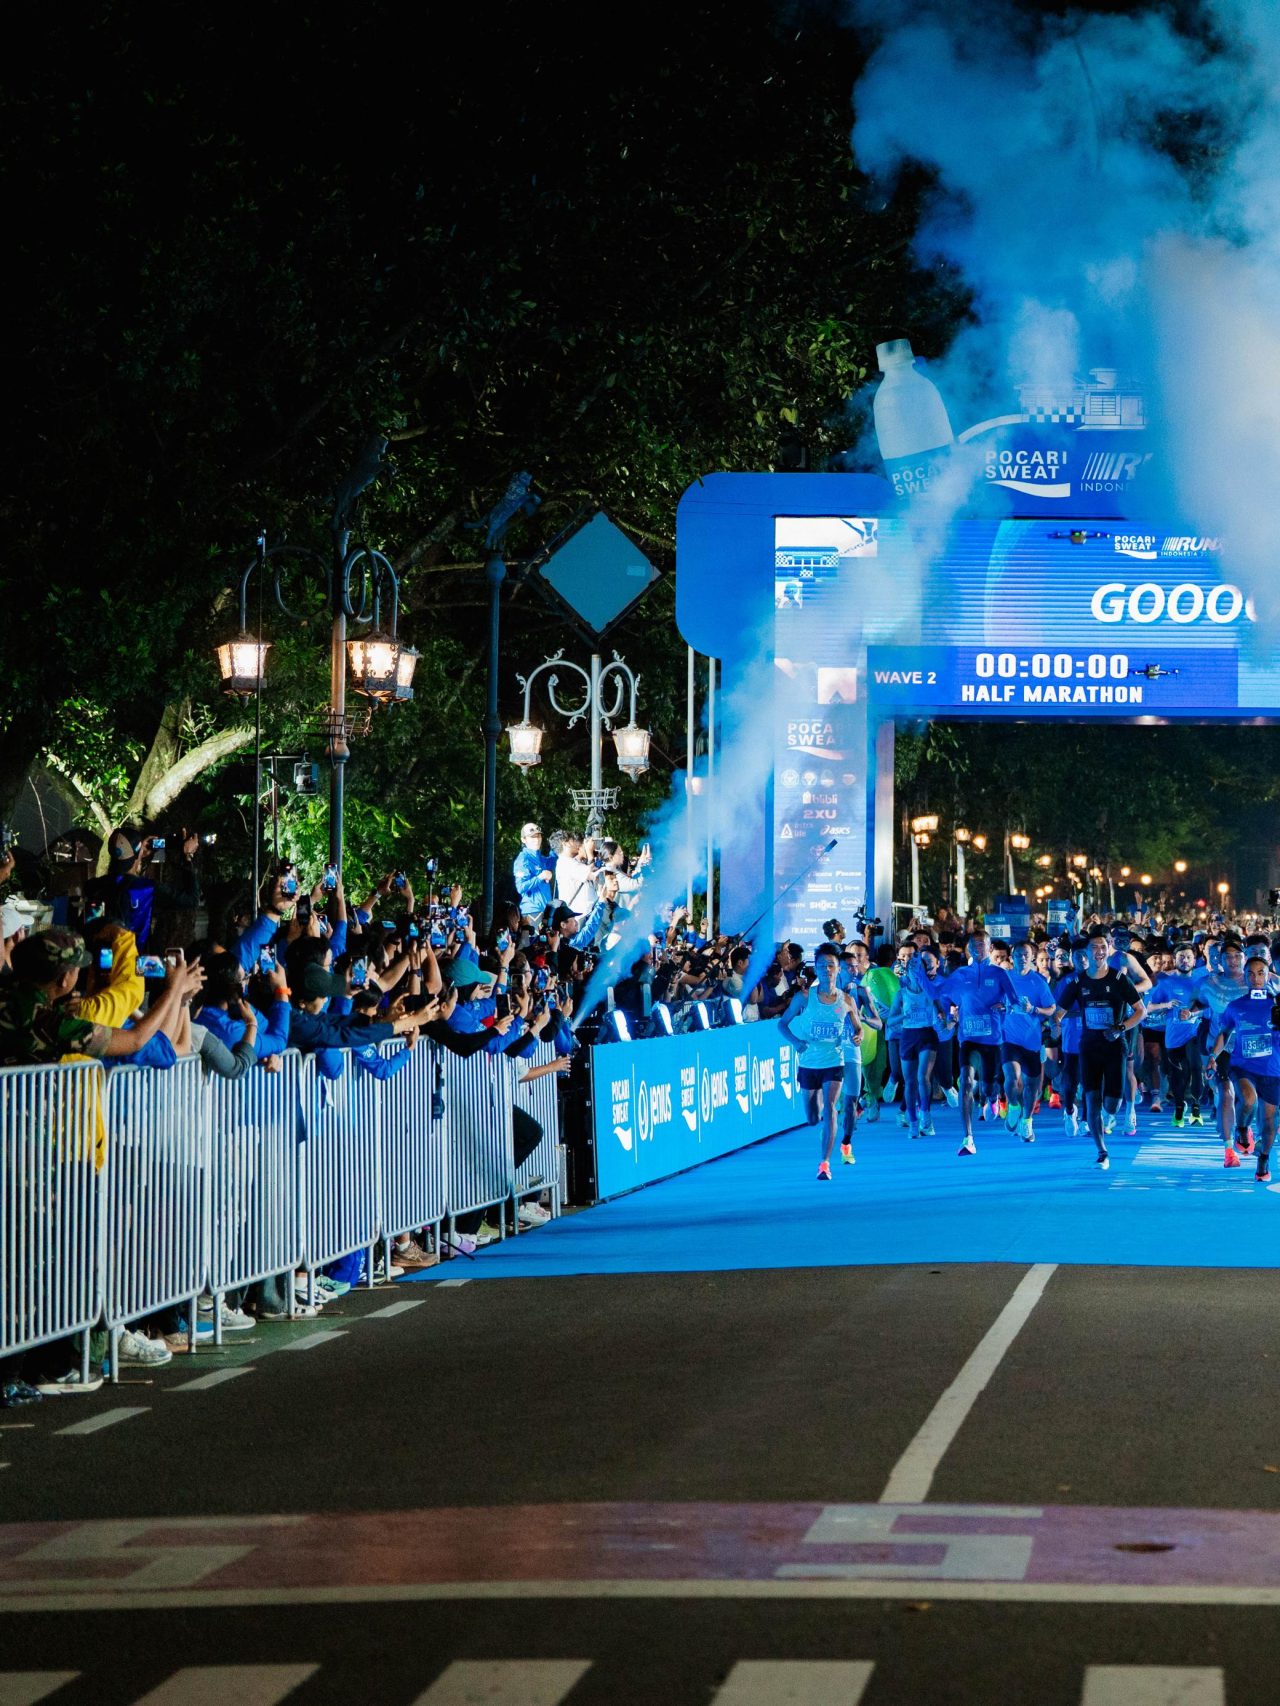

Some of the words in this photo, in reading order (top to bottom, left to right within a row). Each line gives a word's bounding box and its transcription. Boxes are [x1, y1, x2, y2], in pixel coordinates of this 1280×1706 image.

[985, 451, 1067, 465] POCARI
[892, 466, 937, 484] POCA
[985, 465, 1060, 479] SWEAT
[1114, 535, 1155, 543] POCARI
[976, 653, 1128, 678] 00:00:00
[874, 672, 922, 684] WAVE
[927, 672, 936, 684] 2
[962, 685, 1015, 702] HALF
[1023, 686, 1143, 703] MARATHON
[787, 723, 833, 734] POCA
[787, 735, 835, 745] SWEA
[803, 809, 837, 819] 2XU
[681, 1067, 695, 1087] POCARI
[611, 1079, 630, 1102] POCARI
[681, 1087, 695, 1108] SWEAT
[612, 1102, 629, 1124] SWEAT
